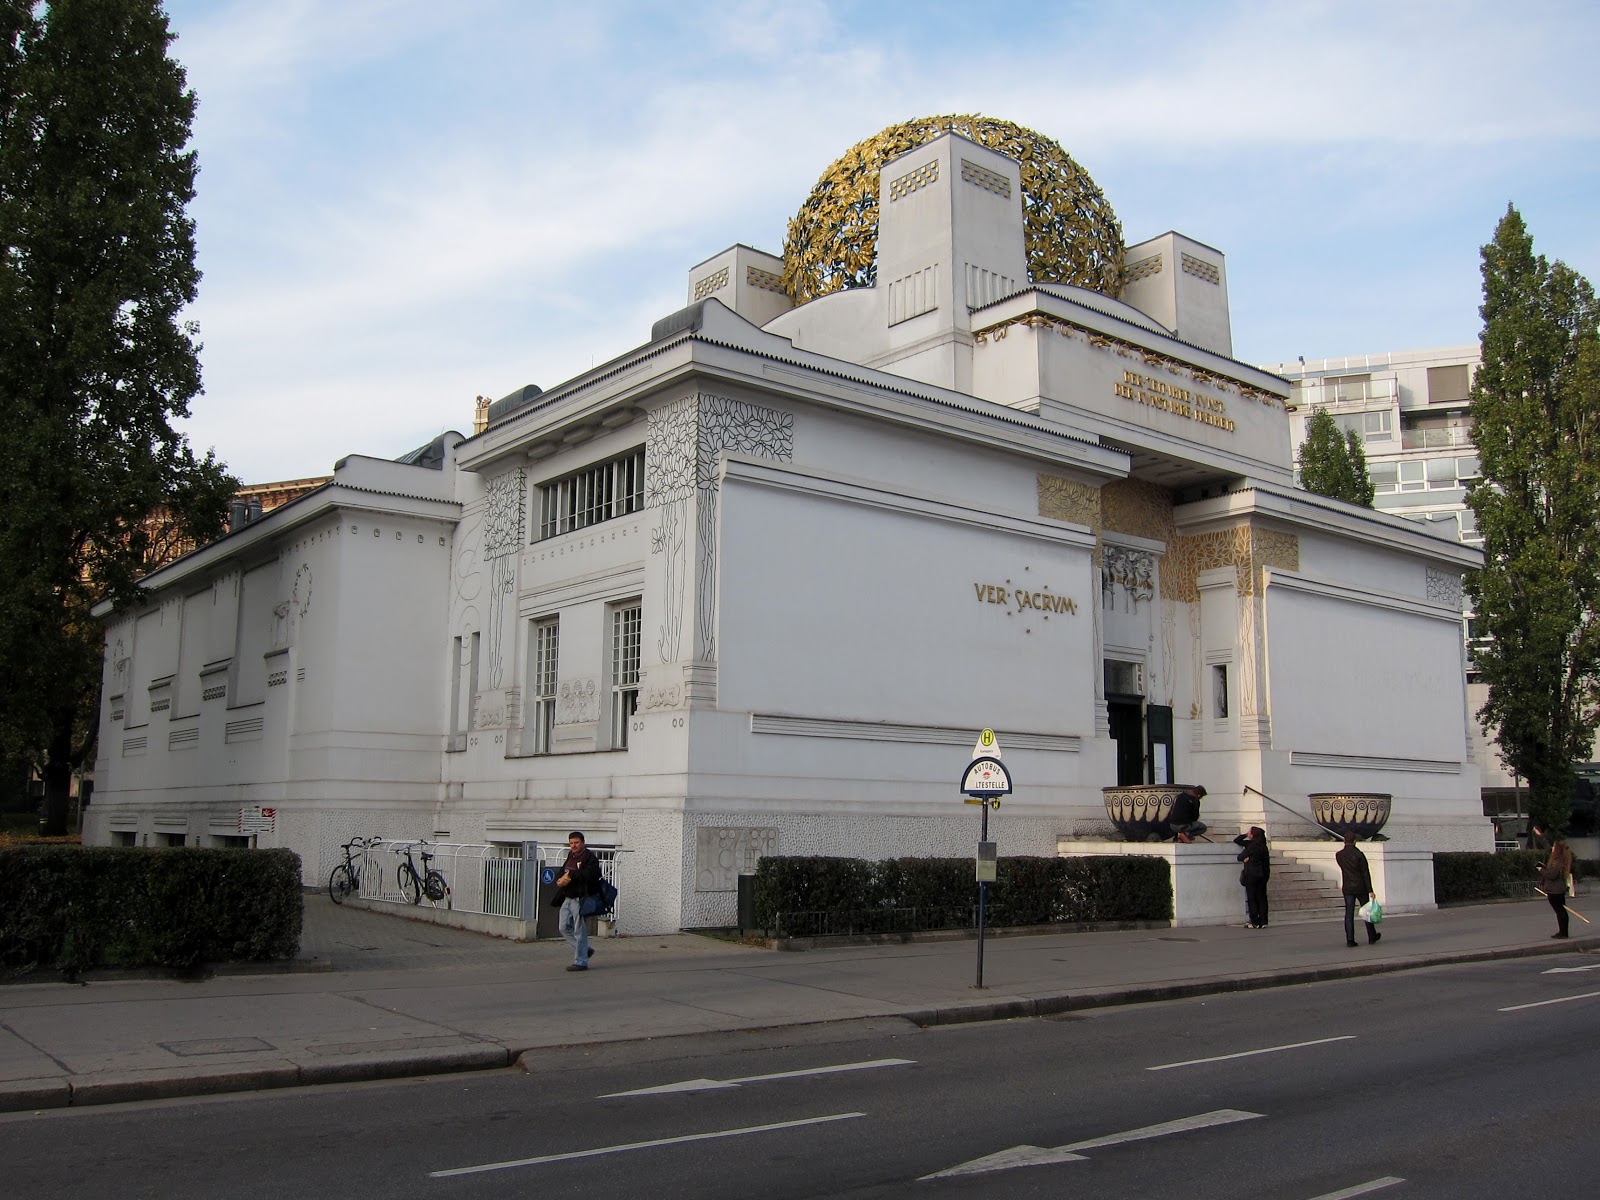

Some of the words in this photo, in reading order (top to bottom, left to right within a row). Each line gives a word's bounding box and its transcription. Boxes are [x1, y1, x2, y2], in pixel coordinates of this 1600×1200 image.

[1123, 370, 1143, 388] DER
[1114, 383, 1134, 400] DER
[974, 583, 1007, 605] VER
[1014, 589, 1075, 615] SACRVM
[983, 732, 991, 743] H
[973, 762, 1001, 775] AUTOBUS
[975, 781, 1005, 789] LTESTELLE
